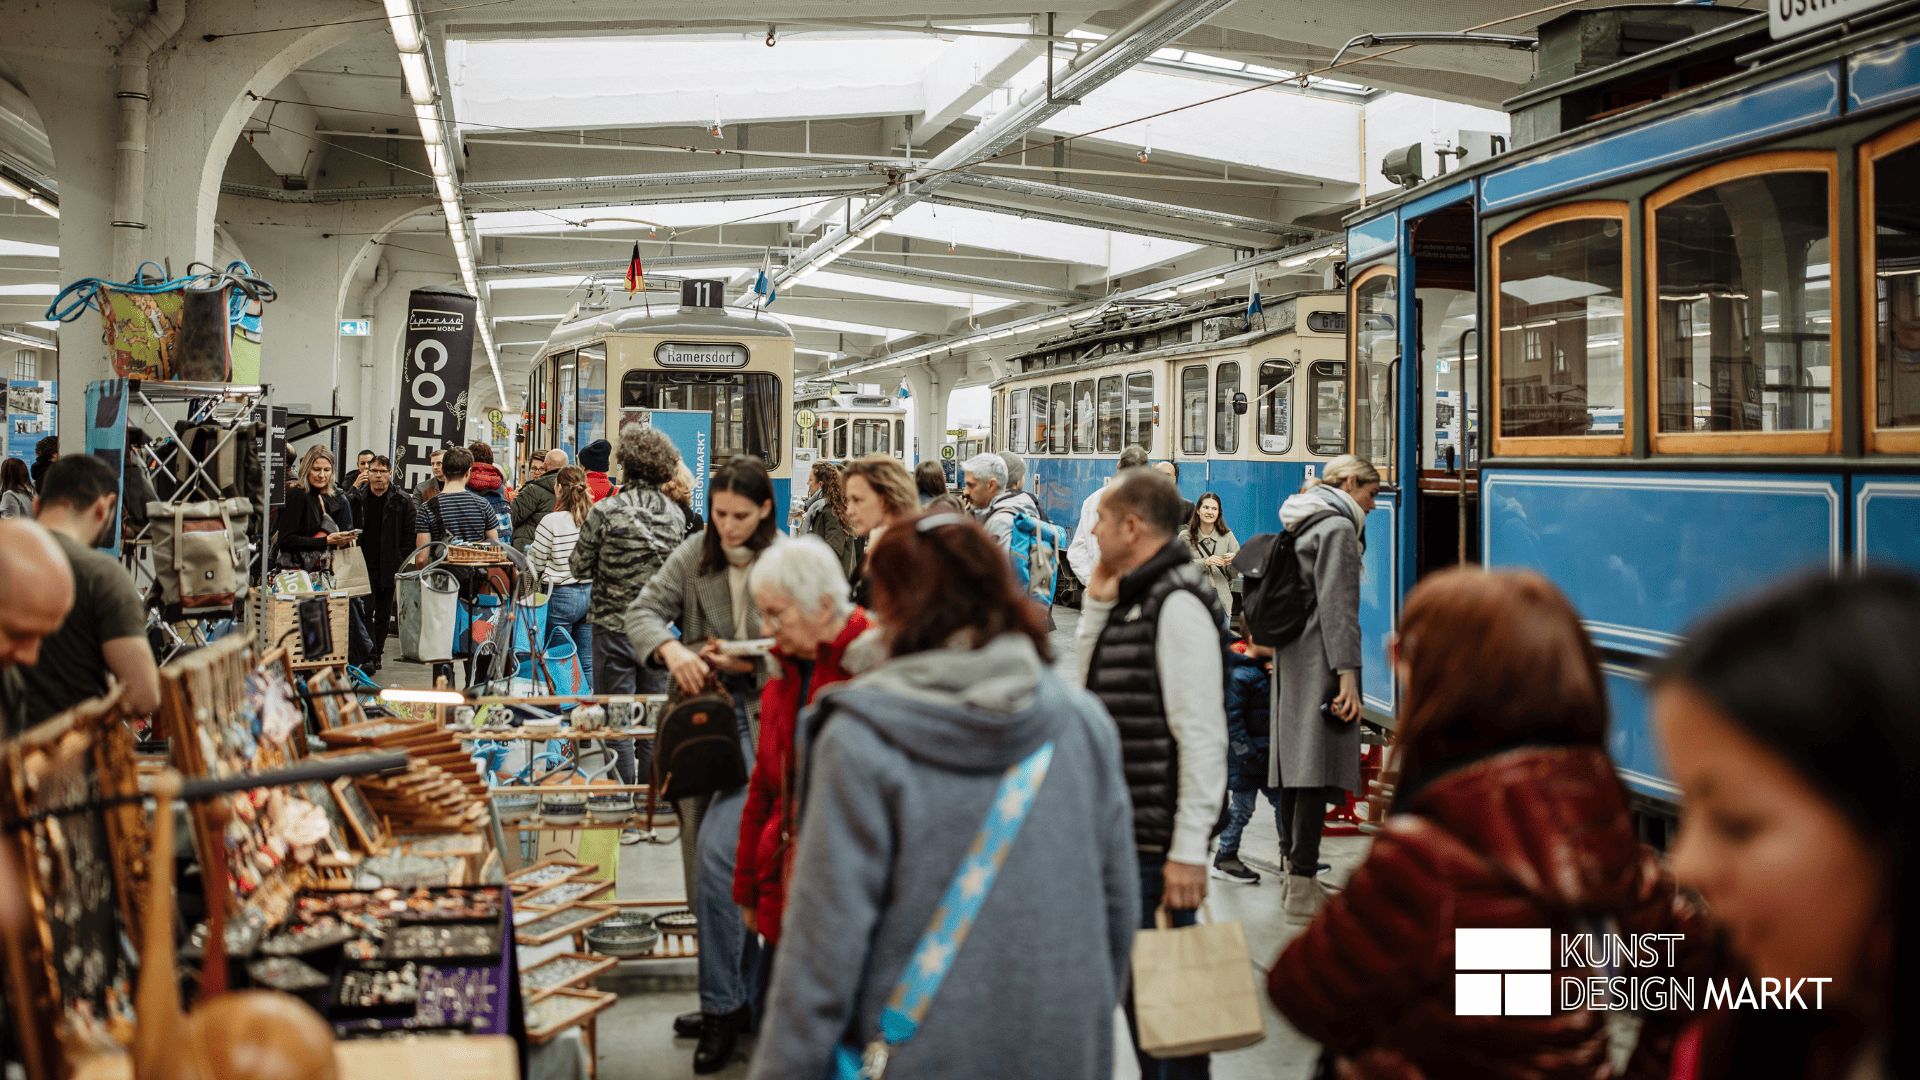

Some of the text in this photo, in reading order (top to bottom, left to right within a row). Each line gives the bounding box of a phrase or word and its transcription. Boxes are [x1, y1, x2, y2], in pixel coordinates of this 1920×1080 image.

[694, 281, 710, 307] 11
[667, 350, 736, 363] Ramersdorf
[404, 338, 448, 497] COFFE
[492, 412, 499, 420] H
[945, 448, 952, 456] H
[694, 431, 706, 515] DESIGNMARKT
[1307, 468, 1312, 476] 4
